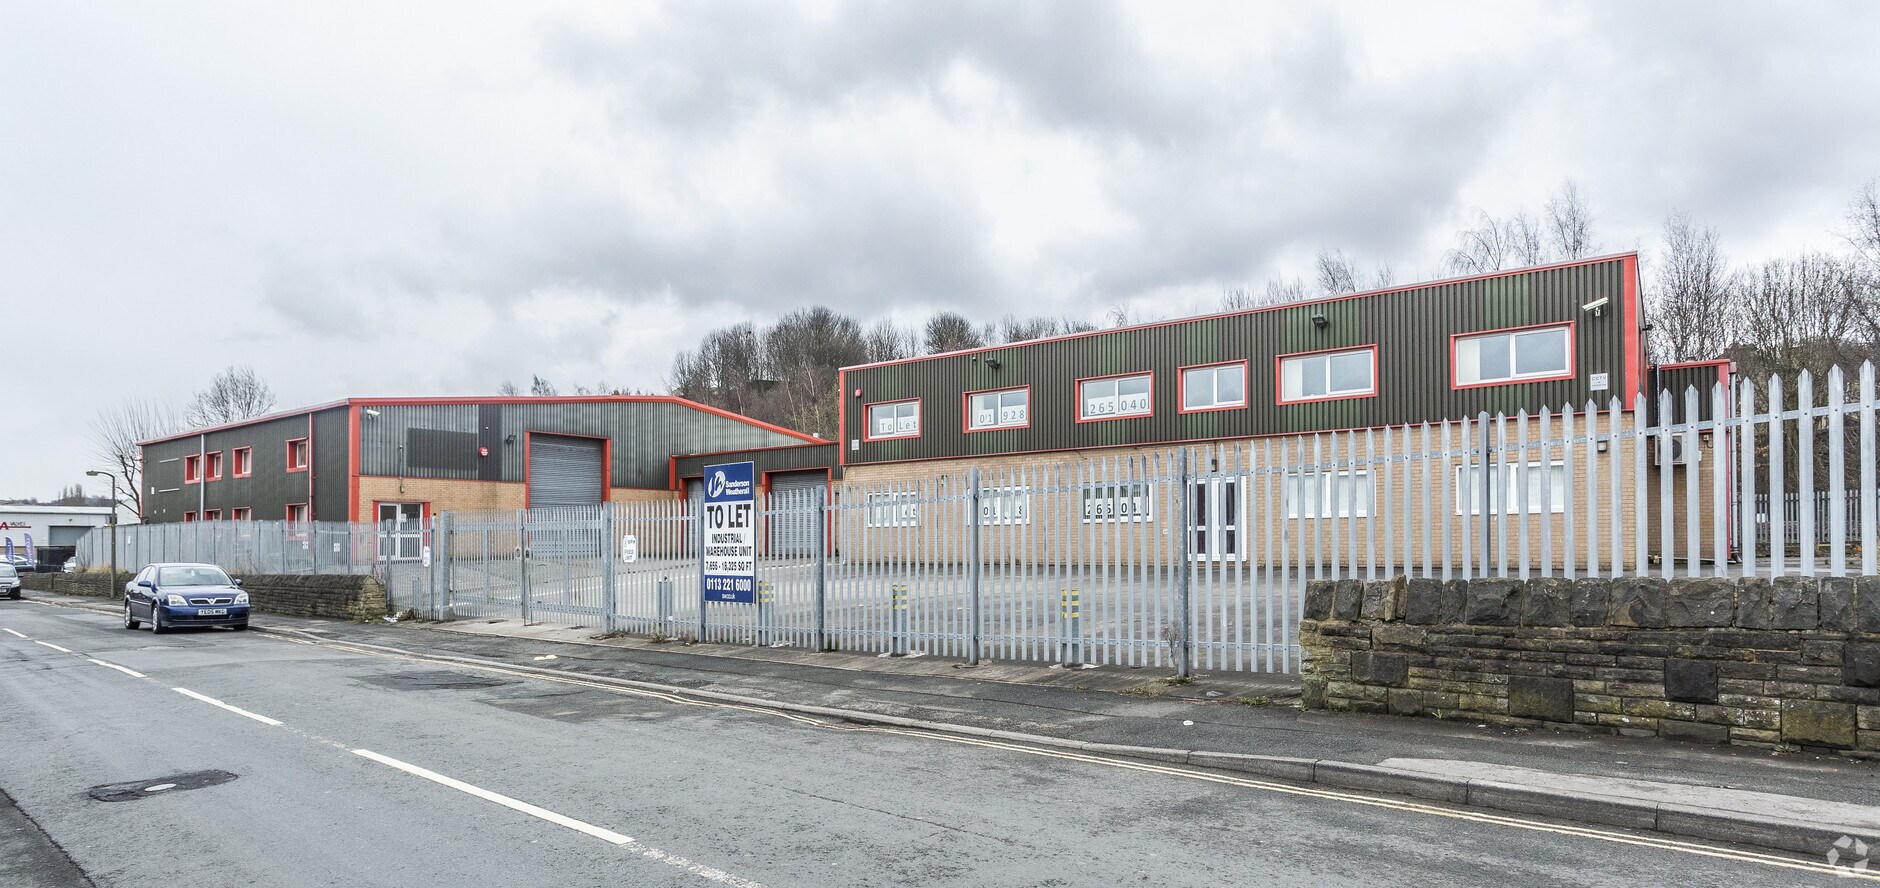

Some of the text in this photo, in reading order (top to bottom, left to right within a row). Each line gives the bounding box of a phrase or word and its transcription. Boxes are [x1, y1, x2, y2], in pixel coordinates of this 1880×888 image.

[1090, 398, 1147, 414] 265 040
[1003, 410, 1025, 421] 928
[881, 420, 916, 431] To Let
[725, 480, 750, 488] Sanderson
[725, 487, 750, 496] Weatherall
[706, 503, 751, 529] TO LET
[711, 533, 743, 544] INDUSTRIAL
[705, 546, 752, 557] WAREHOUSE UNIT
[722, 561, 737, 572] 18,325
[738, 561, 746, 571] SQ
[746, 561, 752, 571] FT
[706, 577, 752, 592] 0113 221 6000
